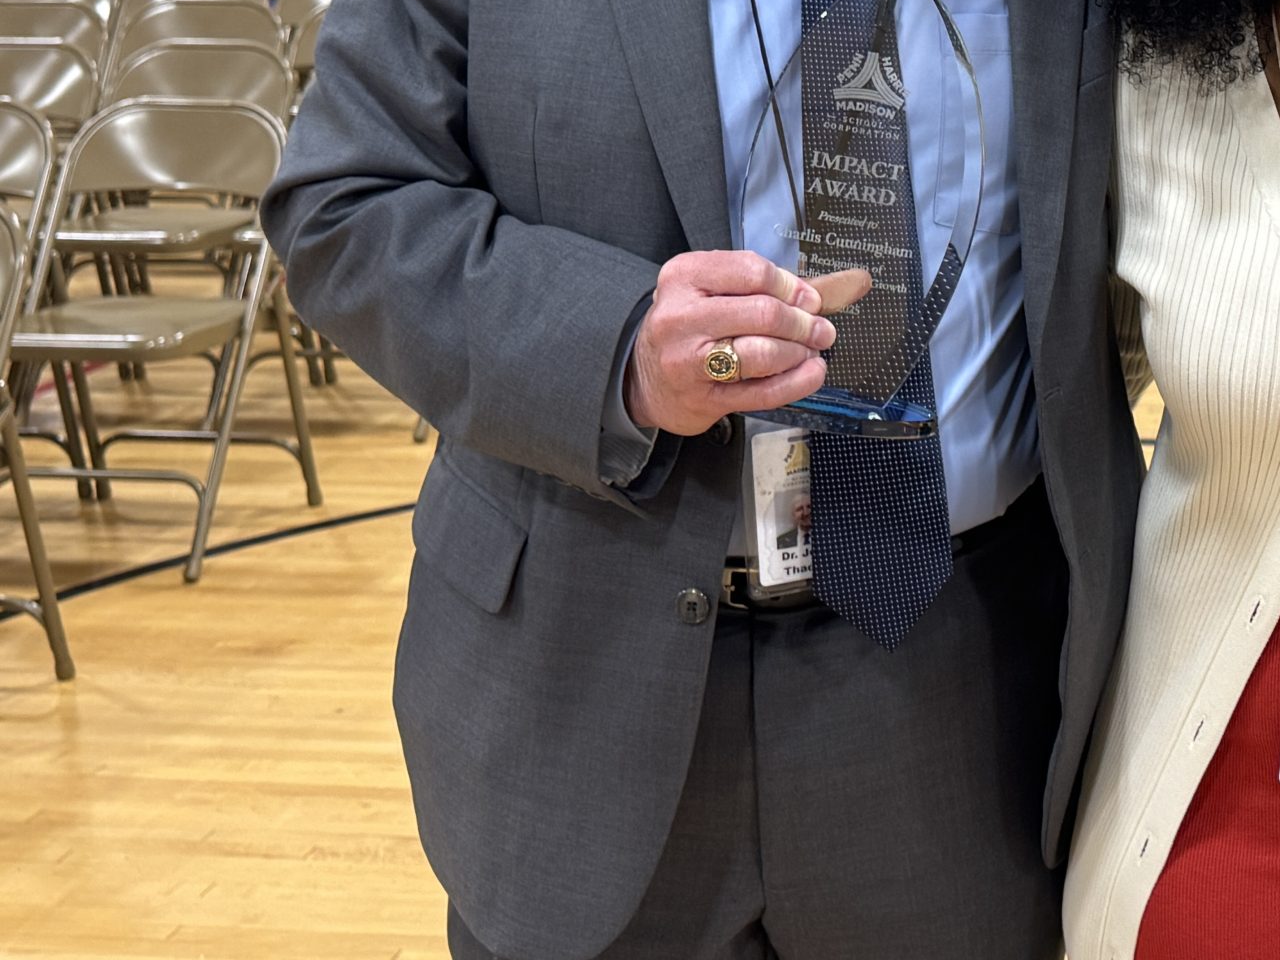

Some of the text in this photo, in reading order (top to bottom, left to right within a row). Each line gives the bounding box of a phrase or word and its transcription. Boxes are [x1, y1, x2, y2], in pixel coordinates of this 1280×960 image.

[837, 52, 864, 83] PENN
[836, 101, 896, 120] MADISON
[823, 121, 900, 140] CORPORATION
[842, 115, 884, 129] SCHOOL
[810, 150, 904, 181] IMPACT
[808, 177, 897, 206] AWARD
[818, 210, 879, 231] Presented to
[773, 223, 913, 259] Charlis Cunningham
[811, 253, 869, 274] Recognition
[871, 264, 885, 276] of
[870, 278, 908, 294] Growth
[840, 303, 860, 316] 025
[782, 551, 798, 561] Dr.
